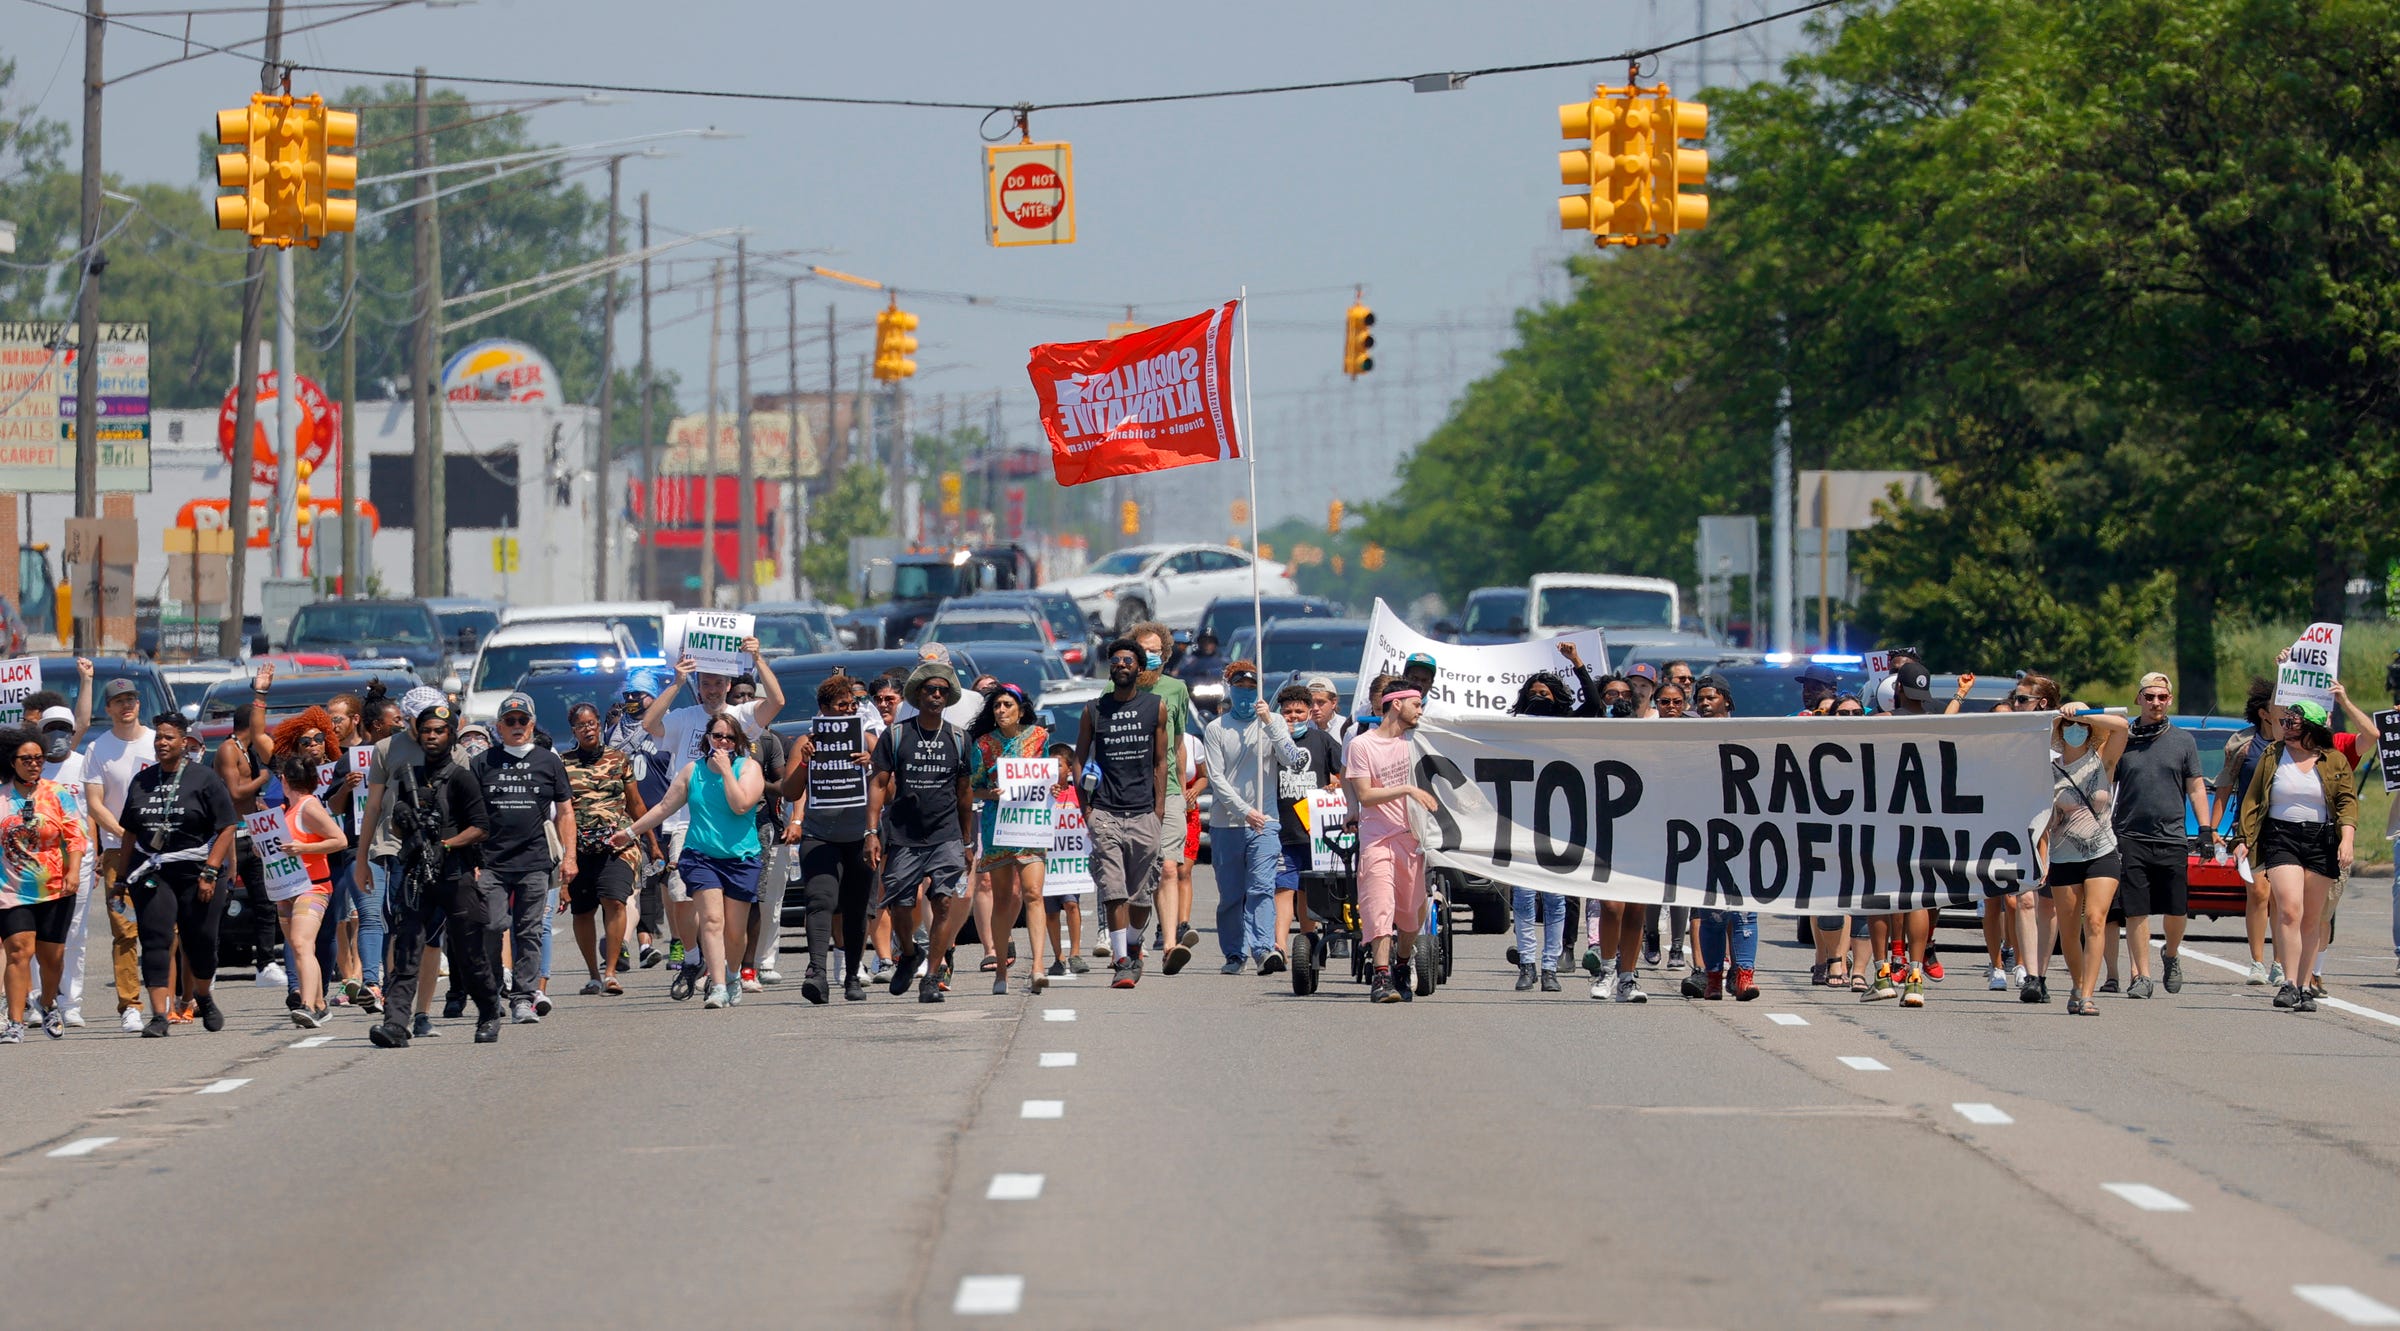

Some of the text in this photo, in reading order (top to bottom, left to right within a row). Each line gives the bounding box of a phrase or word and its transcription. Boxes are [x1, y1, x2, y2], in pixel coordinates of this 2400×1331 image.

[1007, 173, 1056, 189] DO NOT
[1014, 204, 1053, 221] ENTER
[1, 447, 54, 465] CARPET
[699, 616, 737, 629] LIVES
[688, 632, 743, 653] MATTER
[1379, 634, 1397, 658] Stop
[1438, 666, 1482, 684] Terror
[2290, 647, 2328, 667] LIVES
[1, 664, 33, 683] LACK
[2281, 667, 2333, 689] MATTER
[0, 687, 31, 705] IVES
[1464, 689, 1507, 711] the
[1112, 710, 1138, 720] STOP
[818, 721, 849, 734] STOP
[1110, 722, 1142, 733] Racial
[815, 740, 853, 752] Racial
[917, 740, 944, 749] STOP
[1104, 734, 1149, 745] Profiling
[914, 752, 946, 761] Racial
[906, 763, 952, 773] Profiling
[1006, 763, 1051, 780] BLACK
[1718, 740, 1984, 816] RACIAL
[1010, 785, 1046, 802] LIVES
[1000, 807, 1052, 826] MATTER
[1416, 753, 1643, 882] STOP
